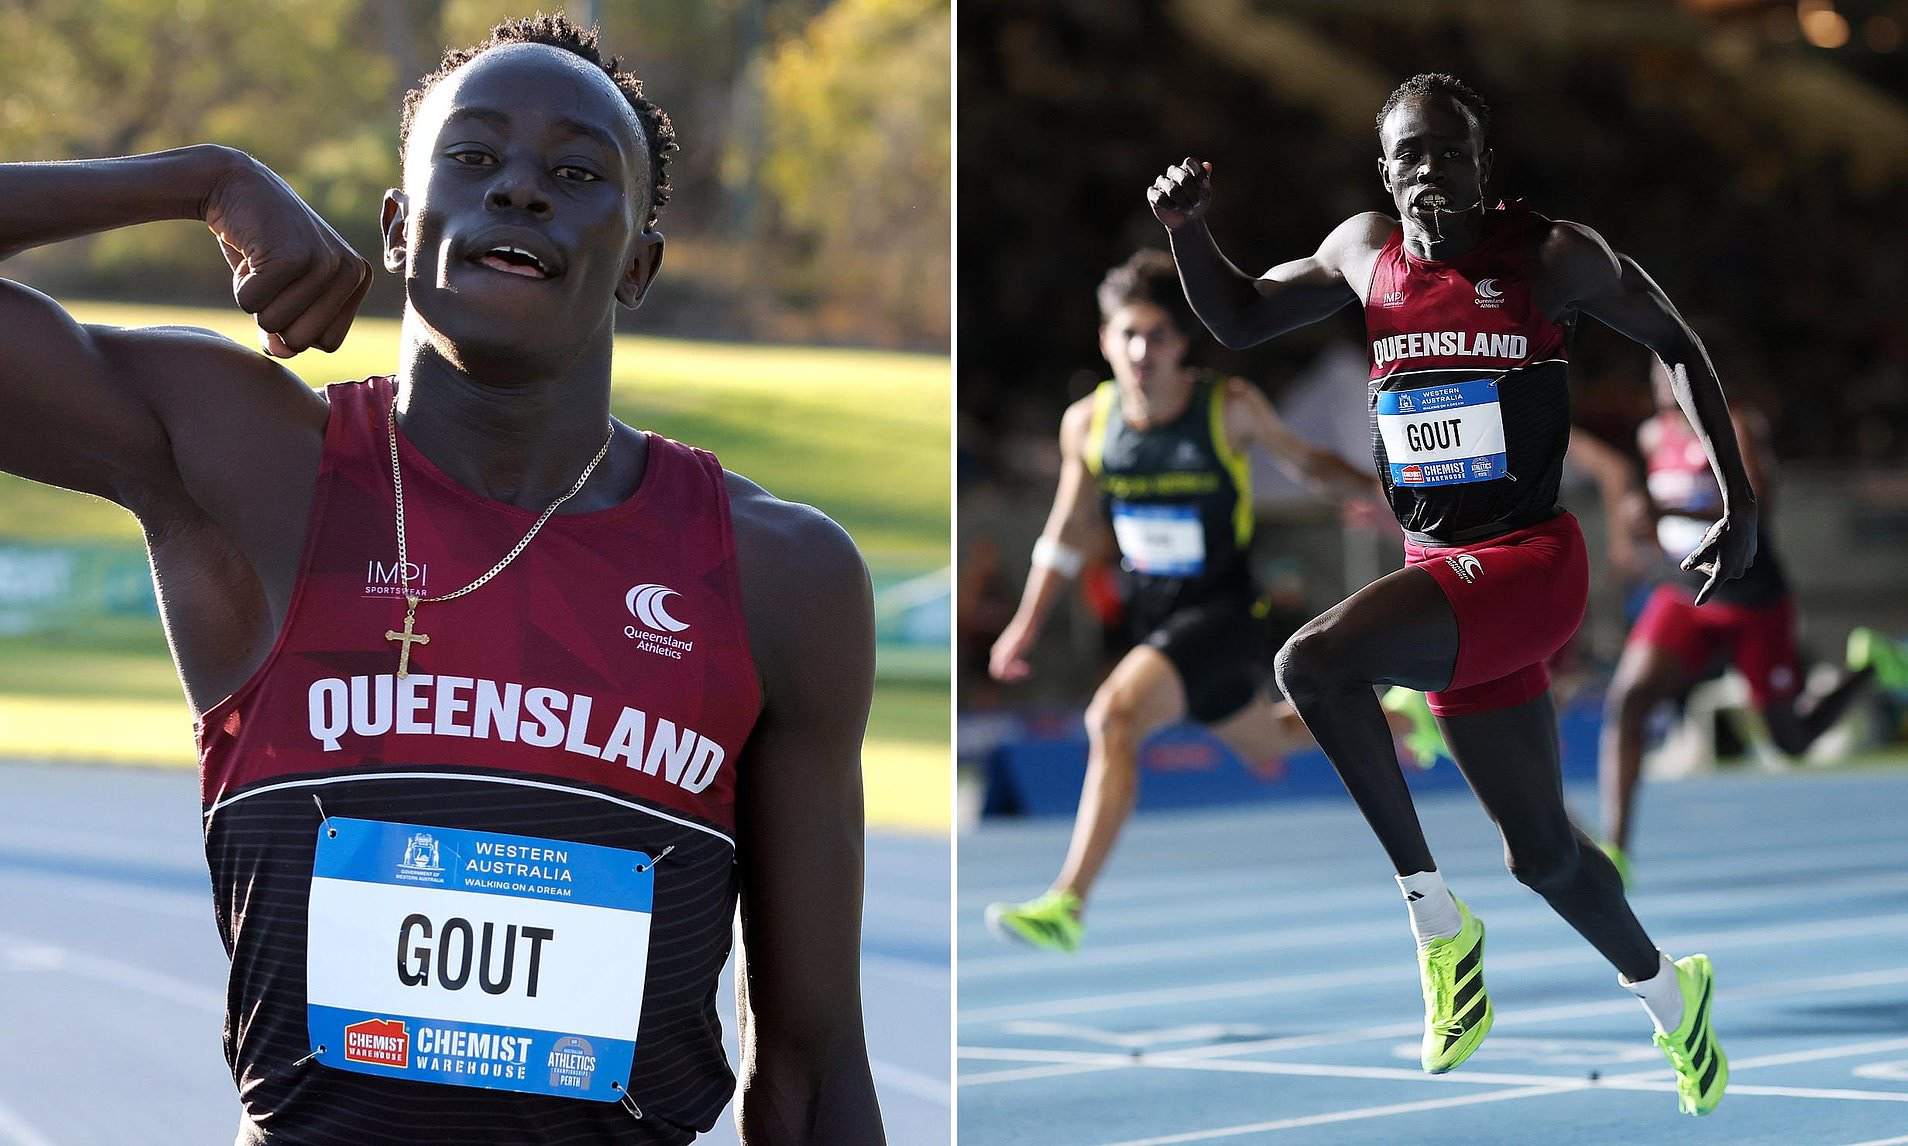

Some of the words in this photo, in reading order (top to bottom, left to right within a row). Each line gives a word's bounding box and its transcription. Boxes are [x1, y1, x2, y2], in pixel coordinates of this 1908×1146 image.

[1383, 291, 1404, 303] IMPI
[1373, 331, 1528, 369] QUEENSLAND
[1421, 393, 1464, 405] AUSTRALIA
[1422, 387, 1460, 398] WESTERN
[1406, 418, 1462, 452] GOUT
[1424, 462, 1465, 477] CHEMIST
[1425, 472, 1466, 482] WAREHOUSE
[367, 560, 427, 586] IMPI
[365, 586, 428, 597] SPORTSEAR
[624, 625, 694, 652] Queensland
[636, 640, 682, 660] Athletics
[308, 673, 726, 795] QUEENSLAND
[476, 841, 568, 864] WESTERN
[465, 859, 572, 882] AUSTRALIA
[465, 878, 510, 890] WALKING
[512, 883, 526, 892] ON
[537, 886, 572, 896] DREAM
[397, 913, 554, 998] GOUT
[349, 1031, 405, 1053] CHEMIST
[417, 1027, 533, 1064] CHEMIST
[349, 1047, 403, 1062] WAREHOUSE
[547, 1051, 596, 1072] ATHLETICS
[416, 1055, 526, 1080] WAREHOUSE
[560, 1075, 581, 1088] PERTH
